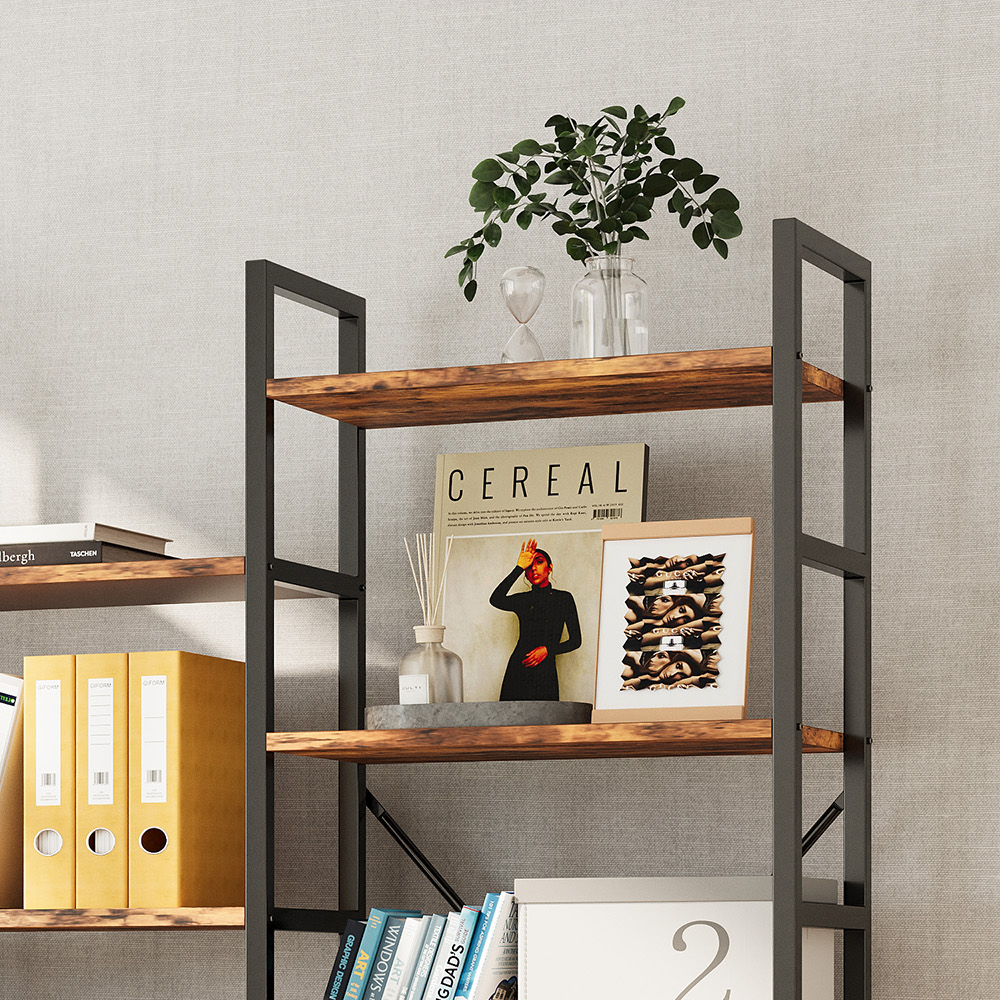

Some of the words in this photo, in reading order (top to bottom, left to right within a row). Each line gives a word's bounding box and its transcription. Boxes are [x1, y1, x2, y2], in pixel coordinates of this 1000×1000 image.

[449, 461, 628, 502] CEREAL
[69, 550, 98, 558] TASCHEN
[429, 924, 442, 947] TEXTILE
[338, 934, 355, 970] GRAPHIC
[353, 949, 370, 980] ART
[370, 925, 401, 992] WINDOWS
[419, 946, 435, 978] DESIGNERS
[441, 944, 464, 989] DAD'S
[329, 970, 344, 1000] DESIGN
